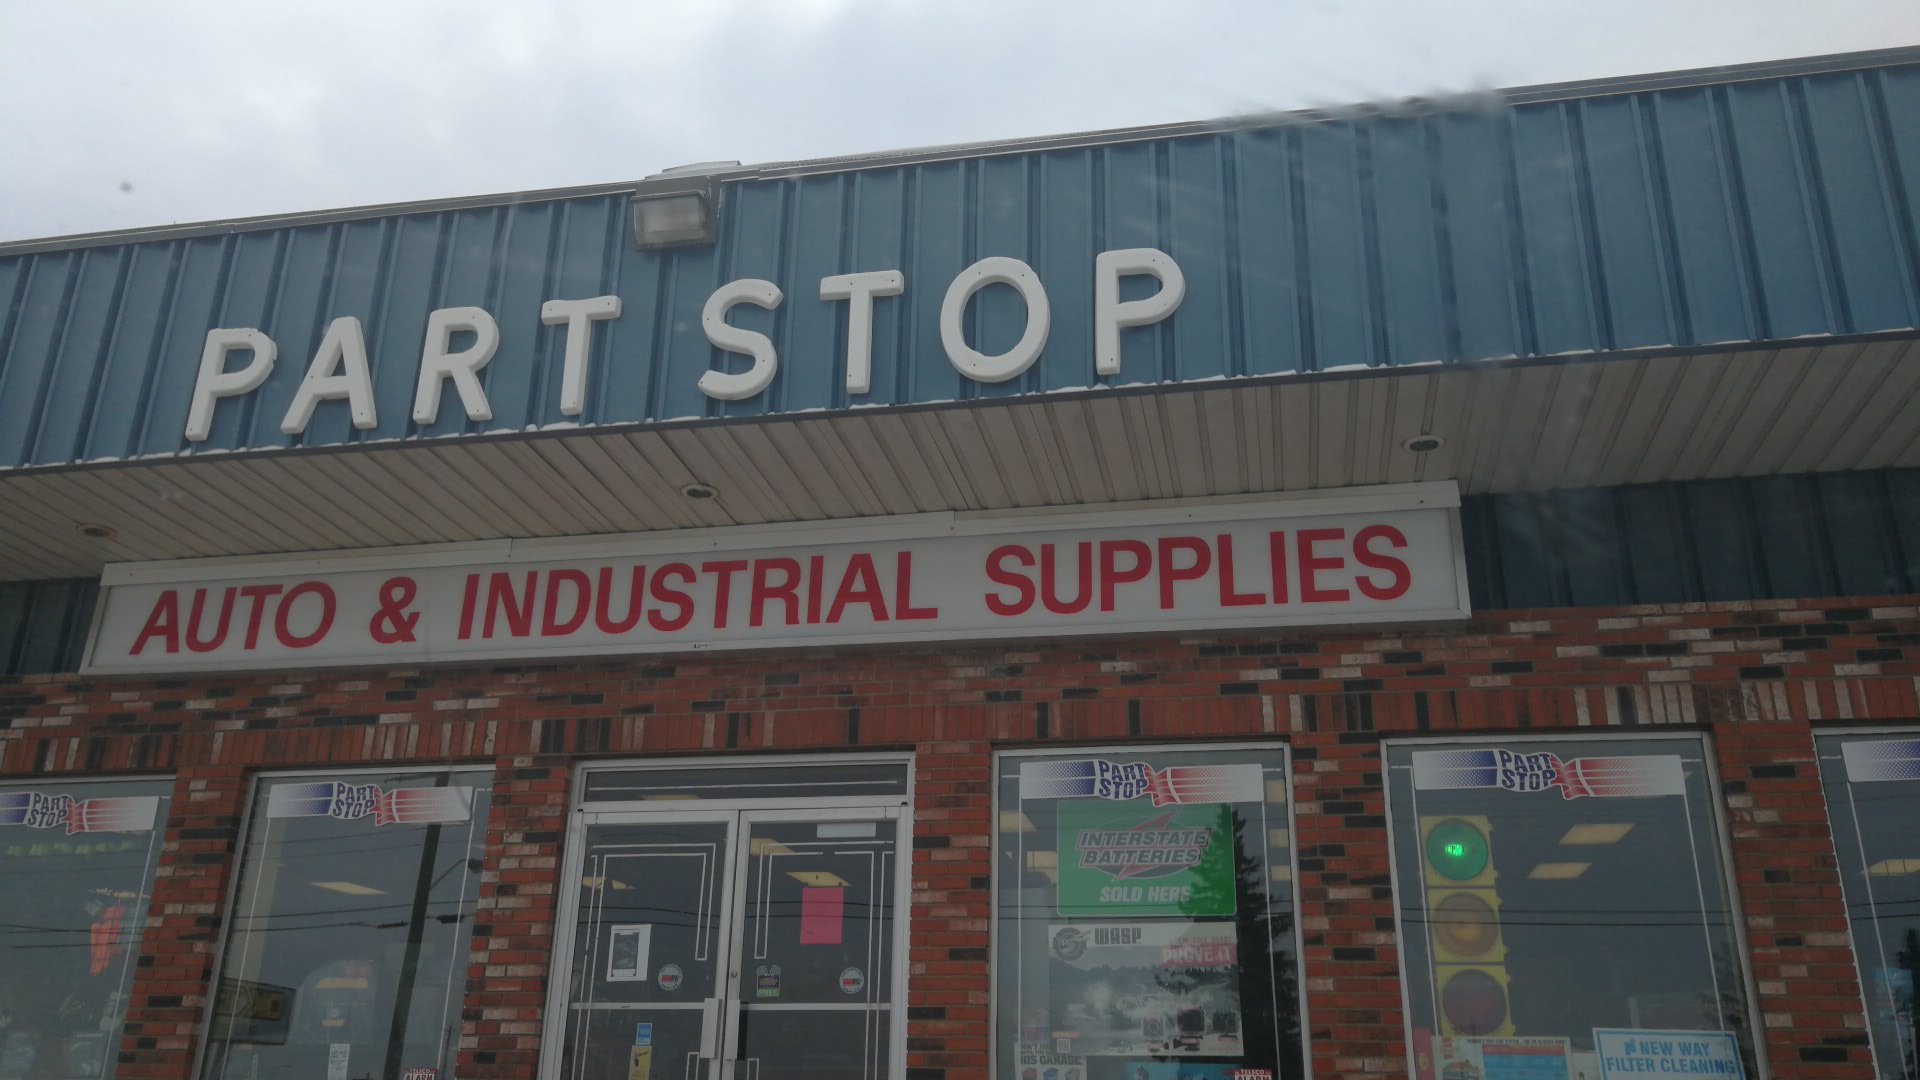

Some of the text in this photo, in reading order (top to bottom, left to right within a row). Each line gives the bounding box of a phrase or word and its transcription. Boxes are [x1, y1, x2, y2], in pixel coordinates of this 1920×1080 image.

[185, 247, 1186, 441] PART STOP
[128, 525, 1411, 655] AUTO & INDUSTRIAL SUPPLIES
[1098, 760, 1147, 782] PART
[1498, 749, 1551, 773] PART
[1098, 778, 1150, 799] STOP
[1501, 768, 1556, 791] STOP
[32, 792, 69, 812] PART
[336, 782, 376, 803] PART
[27, 808, 68, 827] STOP
[332, 798, 376, 818] STOP
[1079, 830, 1210, 848] INTERSTATE
[1082, 848, 1202, 865] BATTERIES
[1100, 886, 1191, 902] SOLD HERE
[1094, 927, 1142, 945] WASP
[1640, 1041, 1710, 1056] NEW WAY
[1020, 1055, 1037, 1065] HIS
[1606, 1057, 1737, 1074] FILTER CLEANING
